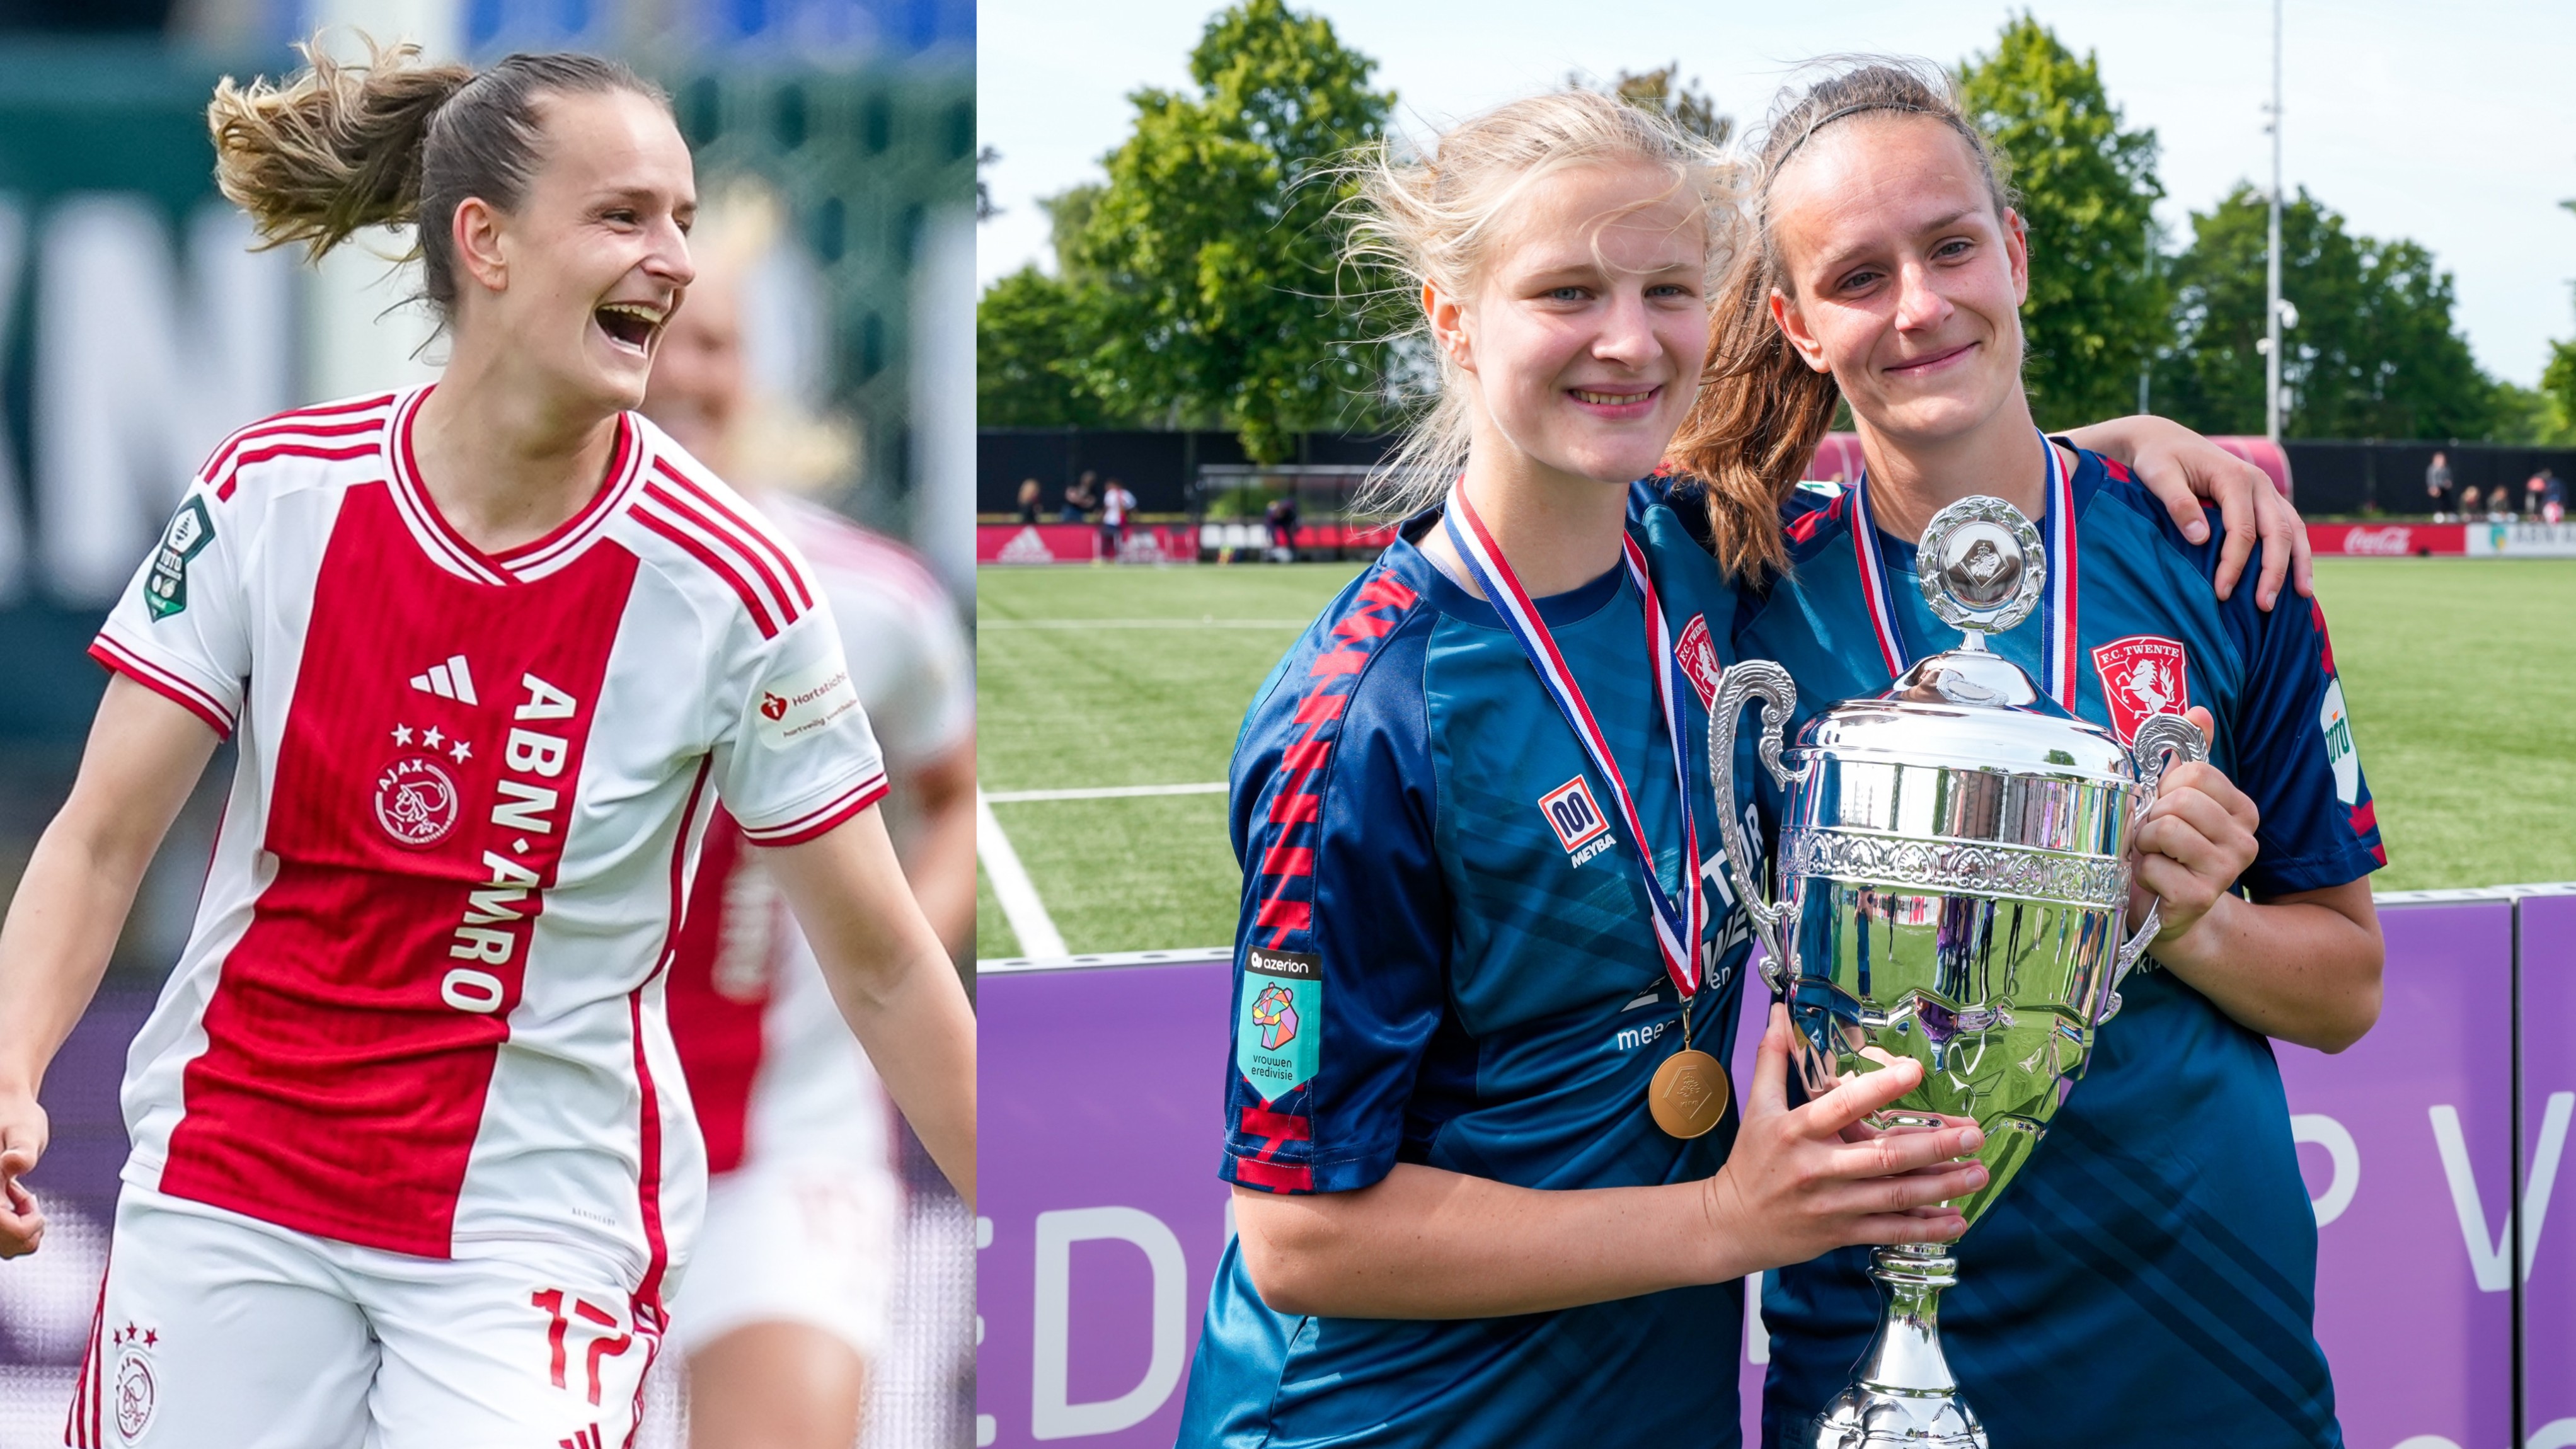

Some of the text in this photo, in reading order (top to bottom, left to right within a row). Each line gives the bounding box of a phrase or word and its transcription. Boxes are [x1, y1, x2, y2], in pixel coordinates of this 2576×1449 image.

[2100, 644, 2180, 664] F.C. TWENTE
[379, 759, 423, 792] AJAX
[1570, 833, 1617, 869] MEYBA
[1263, 958, 1309, 974] azerion
[1253, 1054, 1292, 1068] vrouwen
[1251, 1067, 1293, 1080] eredivisie
[531, 1287, 632, 1407] 17
